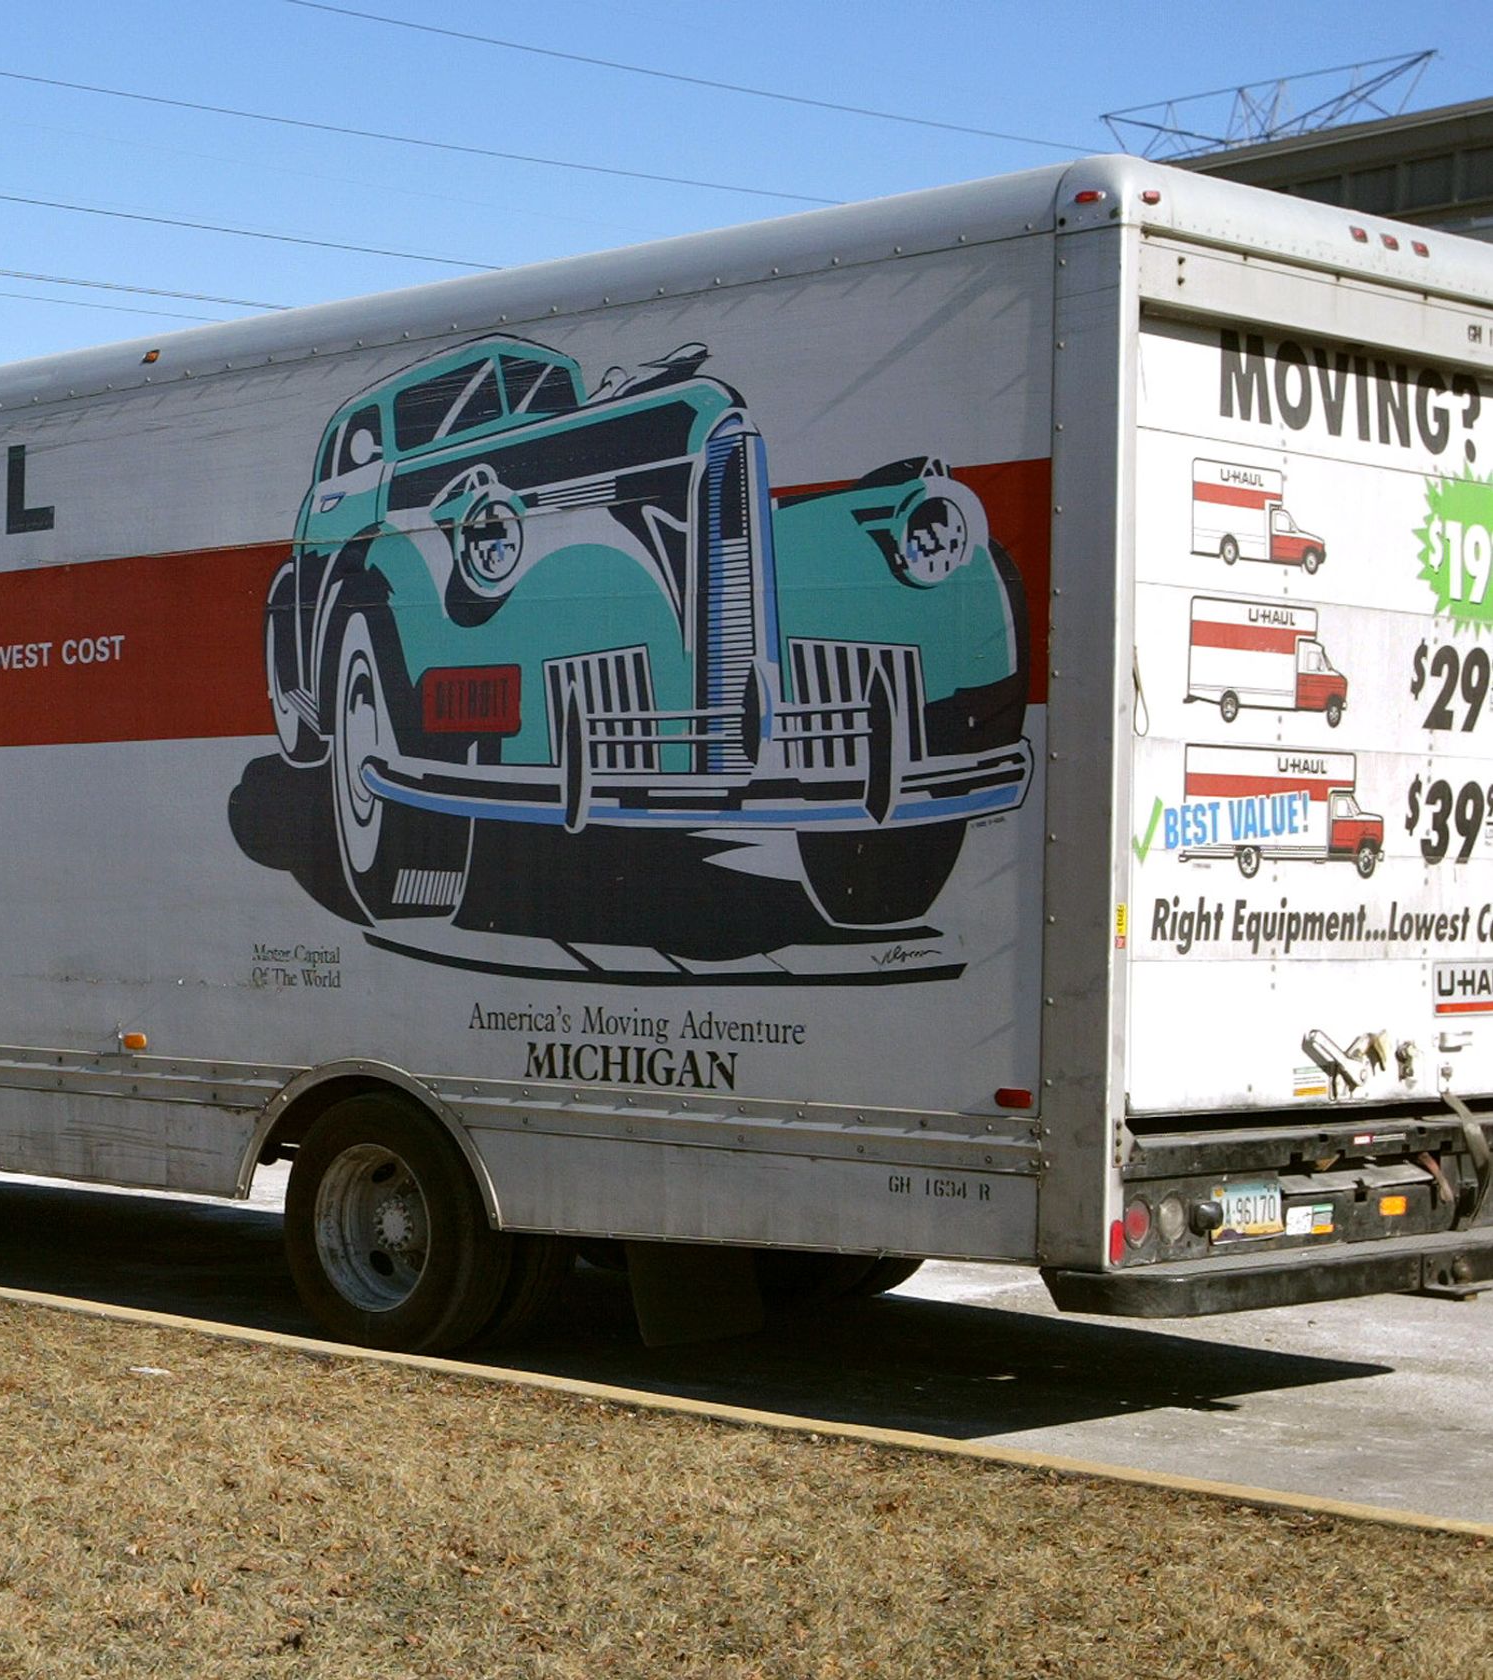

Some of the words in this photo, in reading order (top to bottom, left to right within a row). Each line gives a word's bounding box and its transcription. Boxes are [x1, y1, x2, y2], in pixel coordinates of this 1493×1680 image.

[1219, 328, 1481, 463] MOVING?
[1220, 468, 1264, 487] U-HAUL
[1248, 608, 1296, 626] U-HAUL
[62, 635, 126, 665] COST
[1277, 757, 1328, 774] U-HAUL
[1164, 801, 1220, 850] BEST
[1228, 792, 1310, 841] VALUE!
[1151, 896, 1224, 955] Right
[294, 944, 340, 968] Capital
[252, 966, 269, 989] Of
[272, 968, 297, 986] The
[301, 969, 341, 988] World
[1437, 969, 1493, 997] U-HA
[468, 1002, 572, 1033] America's
[581, 1006, 669, 1044] Moving
[680, 1010, 806, 1044] Adventure
[524, 1041, 738, 1091] MICHIGAN
[889, 1176, 910, 1194] GH
[926, 1178, 967, 1199] 1634
[979, 1183, 991, 1201] R
